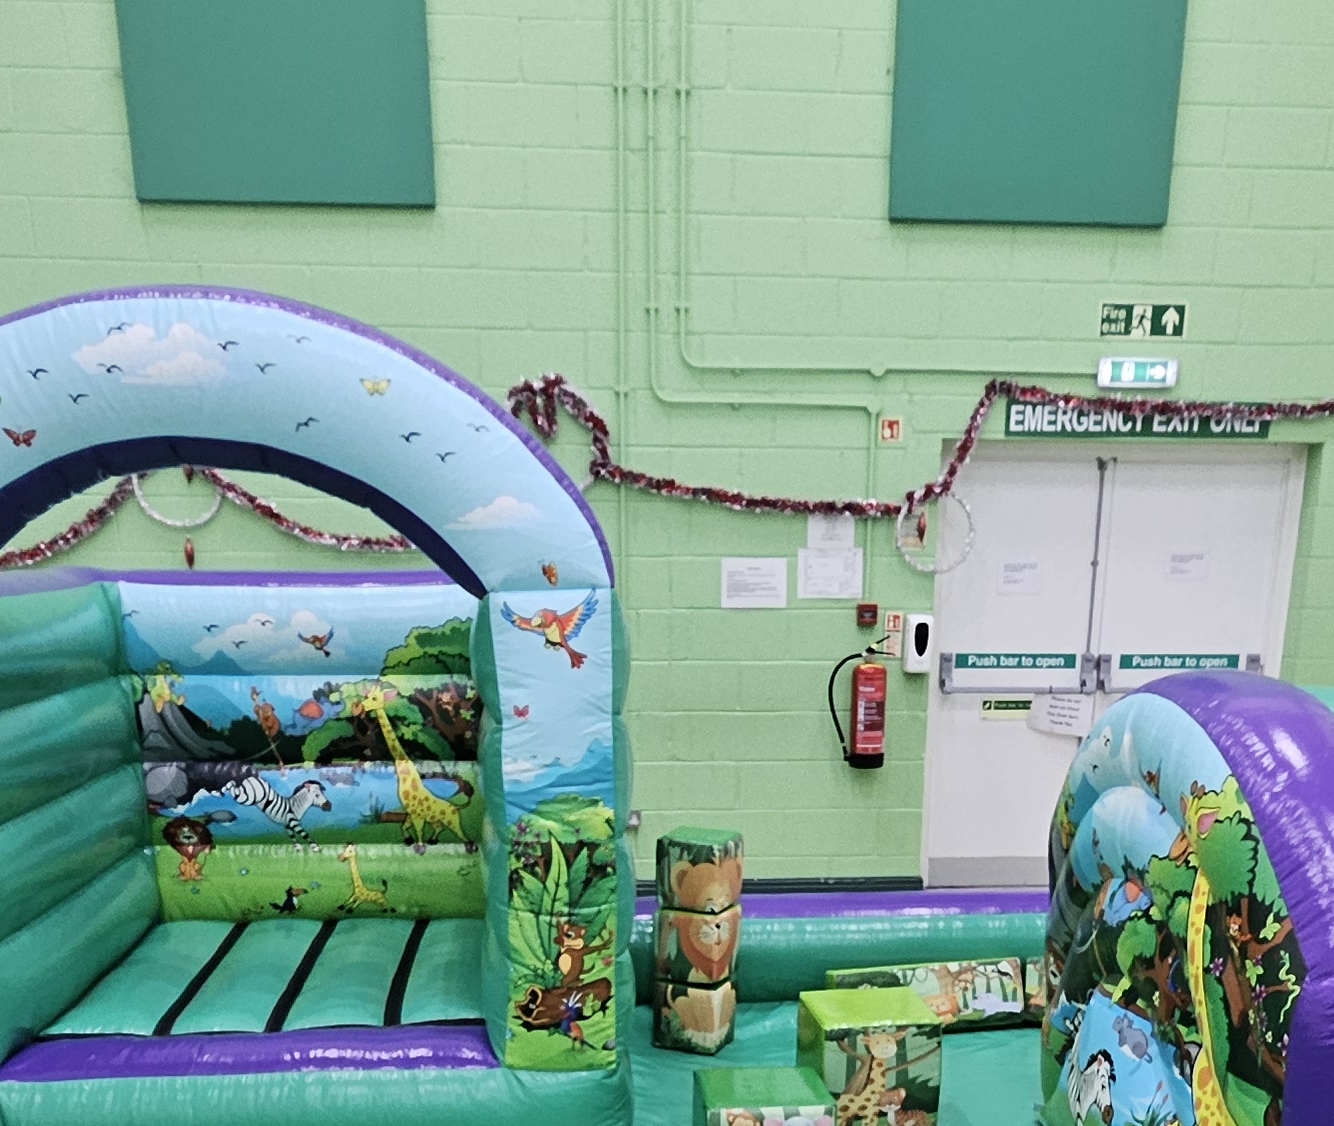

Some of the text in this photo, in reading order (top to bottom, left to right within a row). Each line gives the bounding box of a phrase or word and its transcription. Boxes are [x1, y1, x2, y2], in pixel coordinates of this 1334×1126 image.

[1102, 305, 1127, 320] Fire
[1101, 320, 1126, 334] exit
[1008, 403, 1145, 433] EMERGENCY
[967, 654, 1065, 668] Push bar to open
[1132, 655, 1228, 669] Push bar to open
